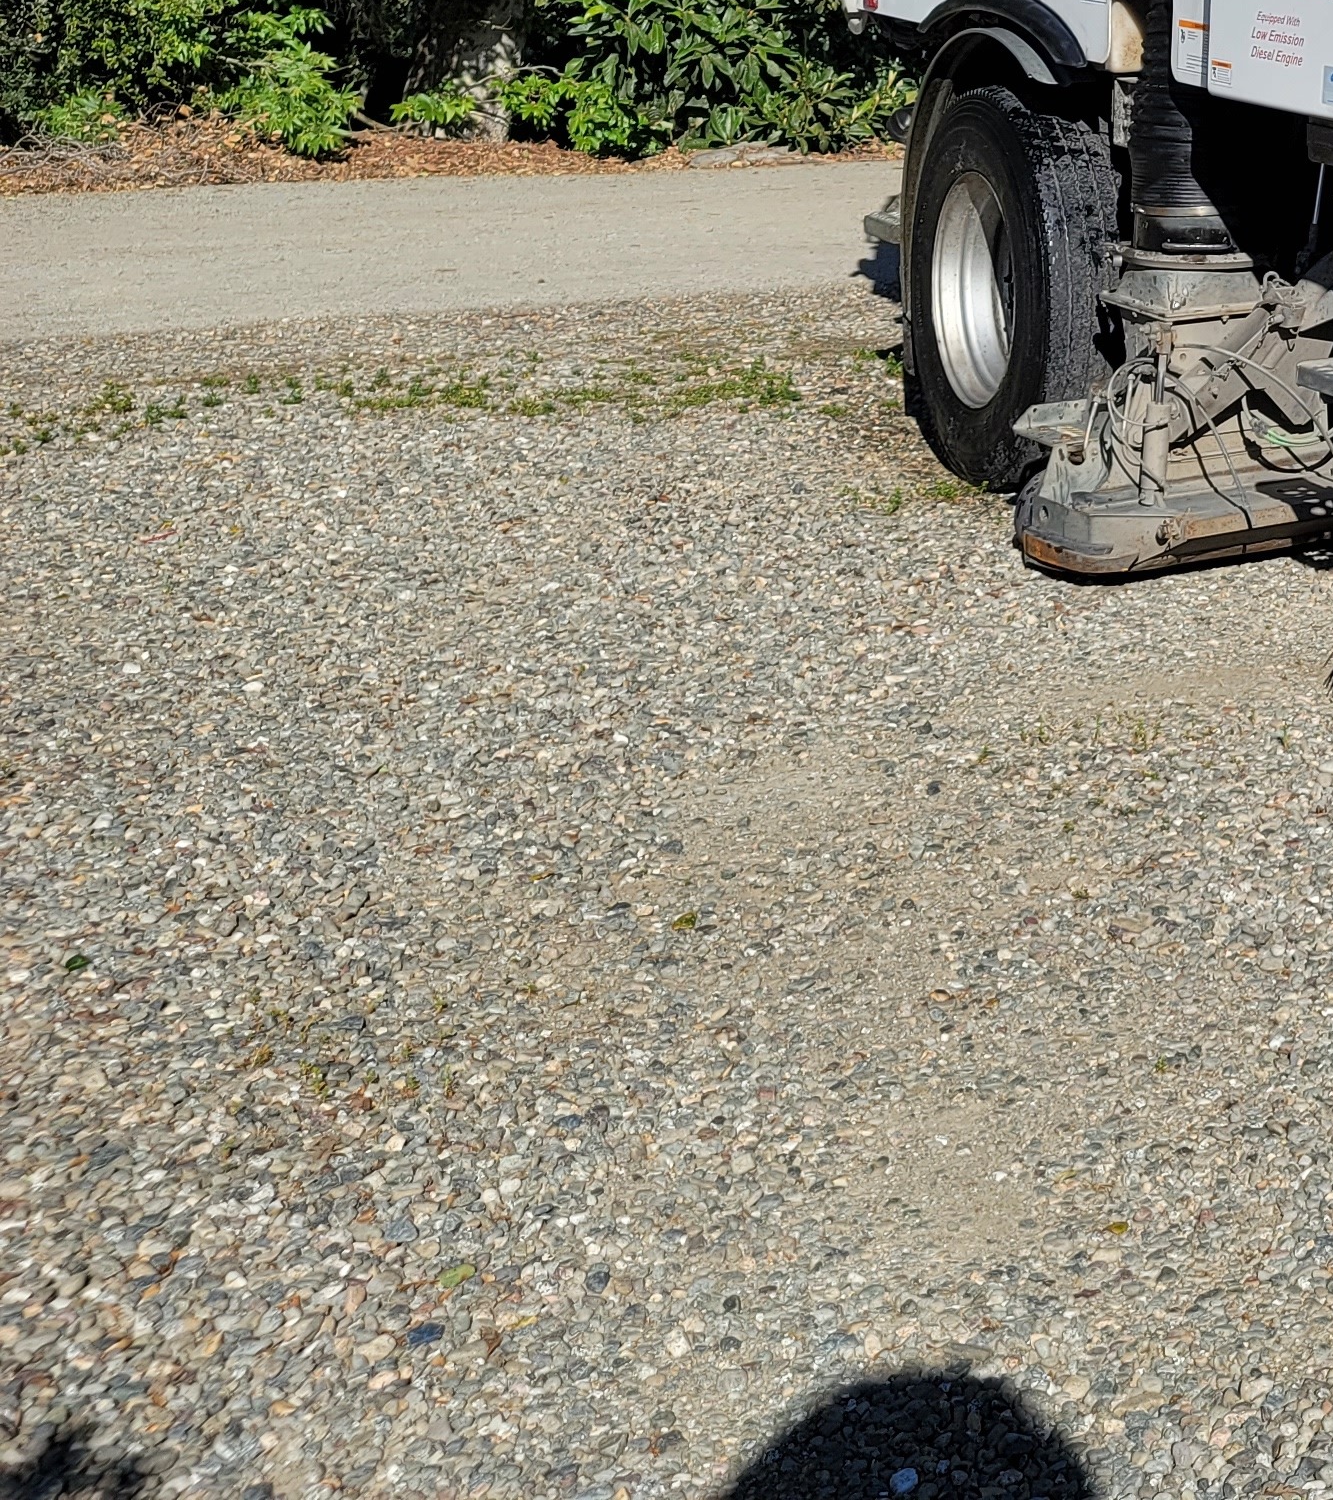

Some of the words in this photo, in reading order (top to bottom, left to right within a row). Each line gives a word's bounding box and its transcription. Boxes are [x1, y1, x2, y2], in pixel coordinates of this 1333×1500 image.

[1257, 10, 1286, 26] Equipped
[1286, 14, 1301, 27] With
[1251, 26, 1269, 41] Low
[1268, 29, 1305, 47] Emission
[1250, 45, 1276, 61] Diesel
[1275, 50, 1303, 67] Engine
